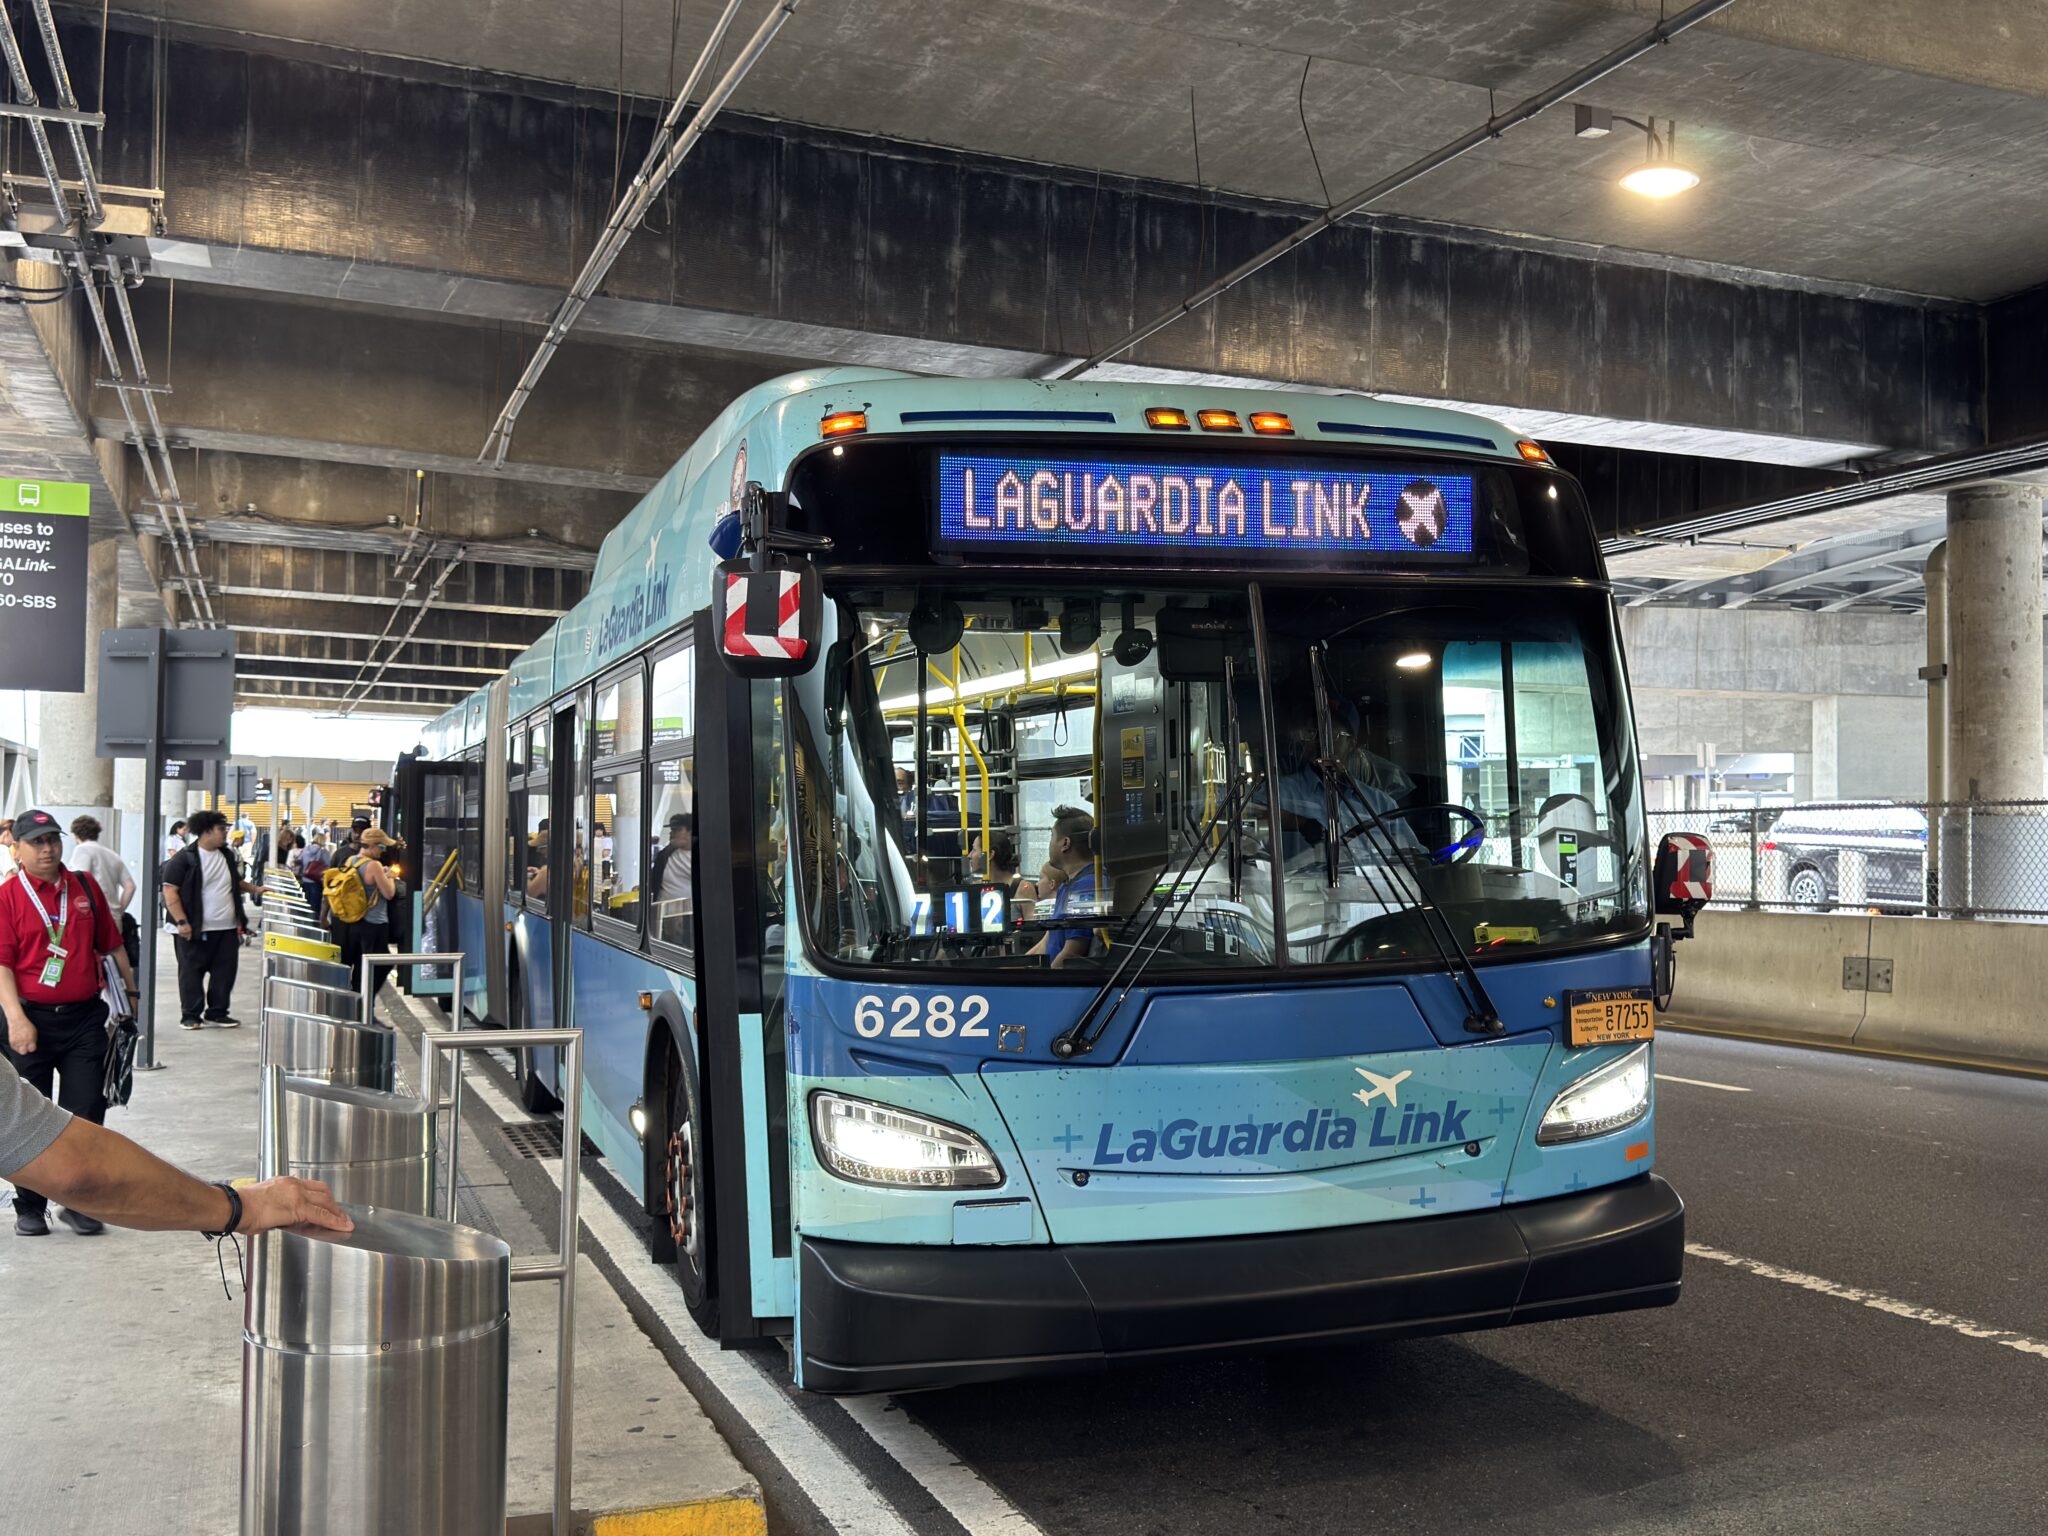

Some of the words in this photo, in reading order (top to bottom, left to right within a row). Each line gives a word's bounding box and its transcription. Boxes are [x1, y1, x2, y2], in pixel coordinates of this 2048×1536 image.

[964, 468, 1246, 535] LAGUARDIA
[1263, 479, 1371, 537] LINK
[37, 523, 54, 536] to
[598, 585, 645, 657] LaGuardia
[645, 563, 670, 629] Link
[854, 995, 990, 1038] 6282
[1591, 993, 1612, 1002] NEW
[1613, 991, 1633, 1001] YORK
[1613, 1031, 1631, 1039] YORK
[1093, 1108, 1358, 1165] LaGuardia
[1369, 1101, 1471, 1146] Link
